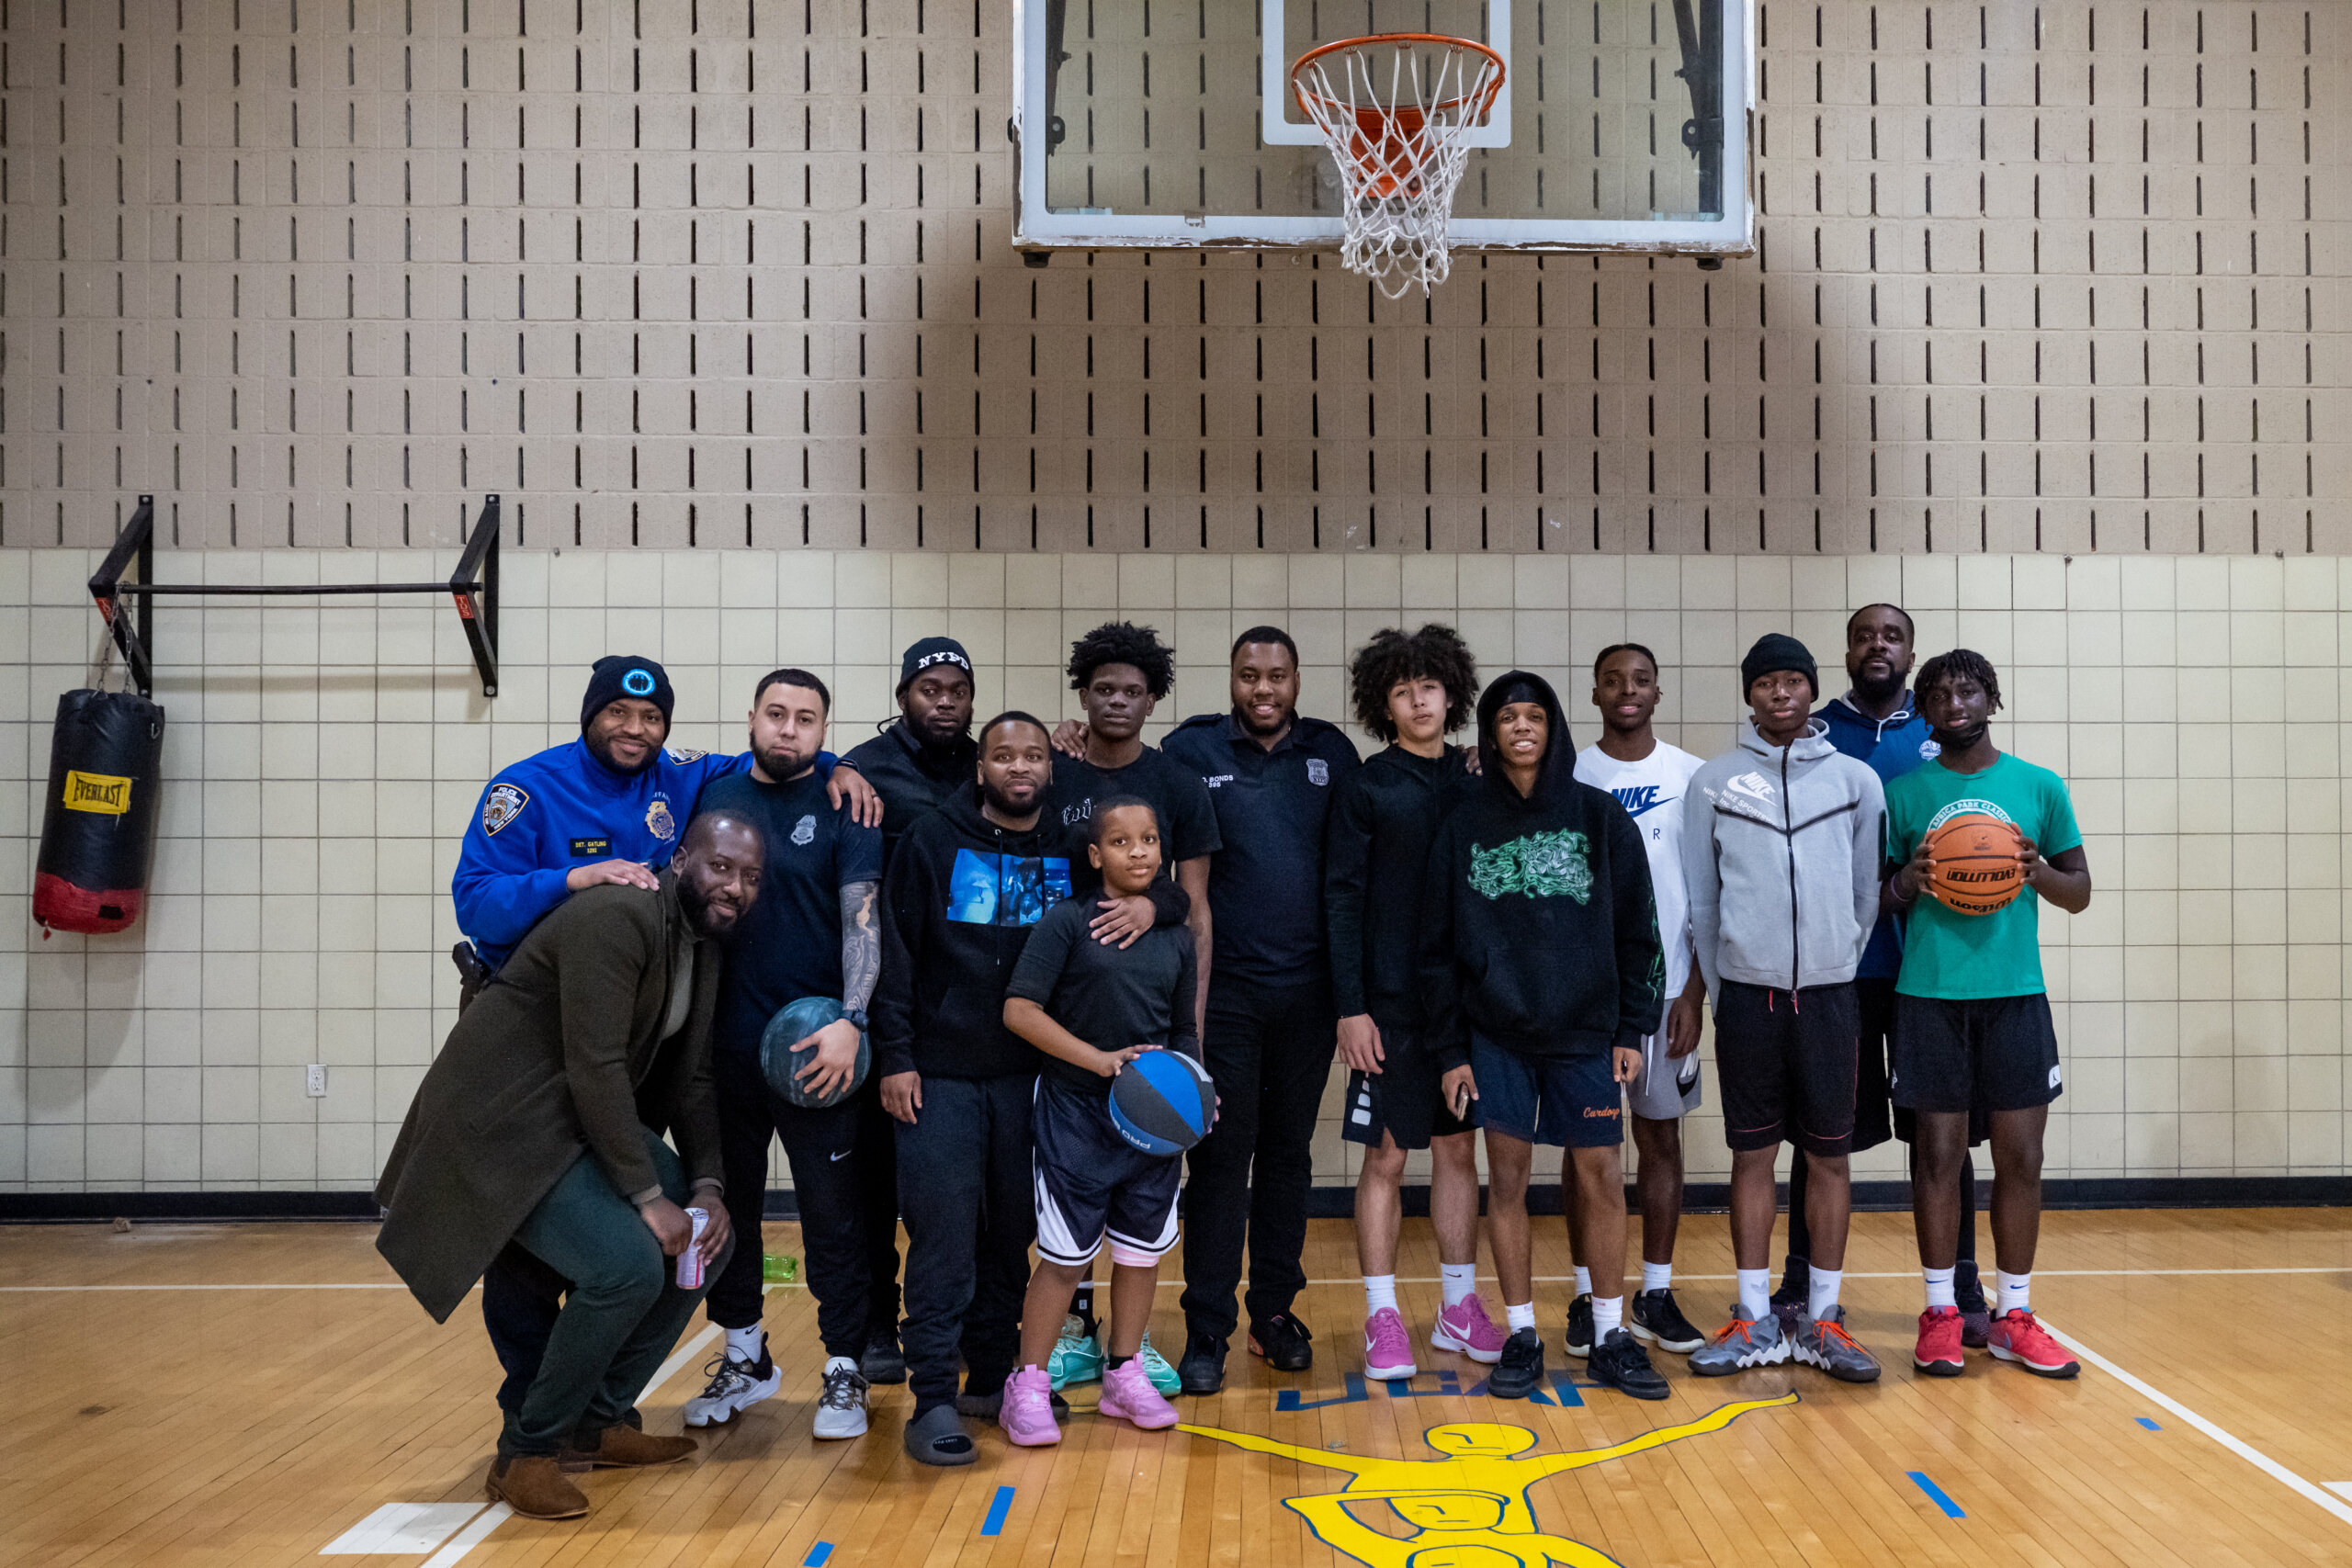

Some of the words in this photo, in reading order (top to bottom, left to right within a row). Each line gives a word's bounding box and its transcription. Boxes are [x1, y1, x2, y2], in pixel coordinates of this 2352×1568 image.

[457, 596, 470, 616] TDS
[918, 651, 969, 670] NYPD
[1209, 774, 1234, 783] BONDS
[1740, 772, 1776, 795] NIKE
[74, 774, 126, 807] EVERLAST
[1611, 785, 1660, 808] NIKE
[1721, 789, 1739, 803] NIKE
[1946, 868, 2016, 883] EVOLUTION
[1950, 897, 2012, 913] Wilson
